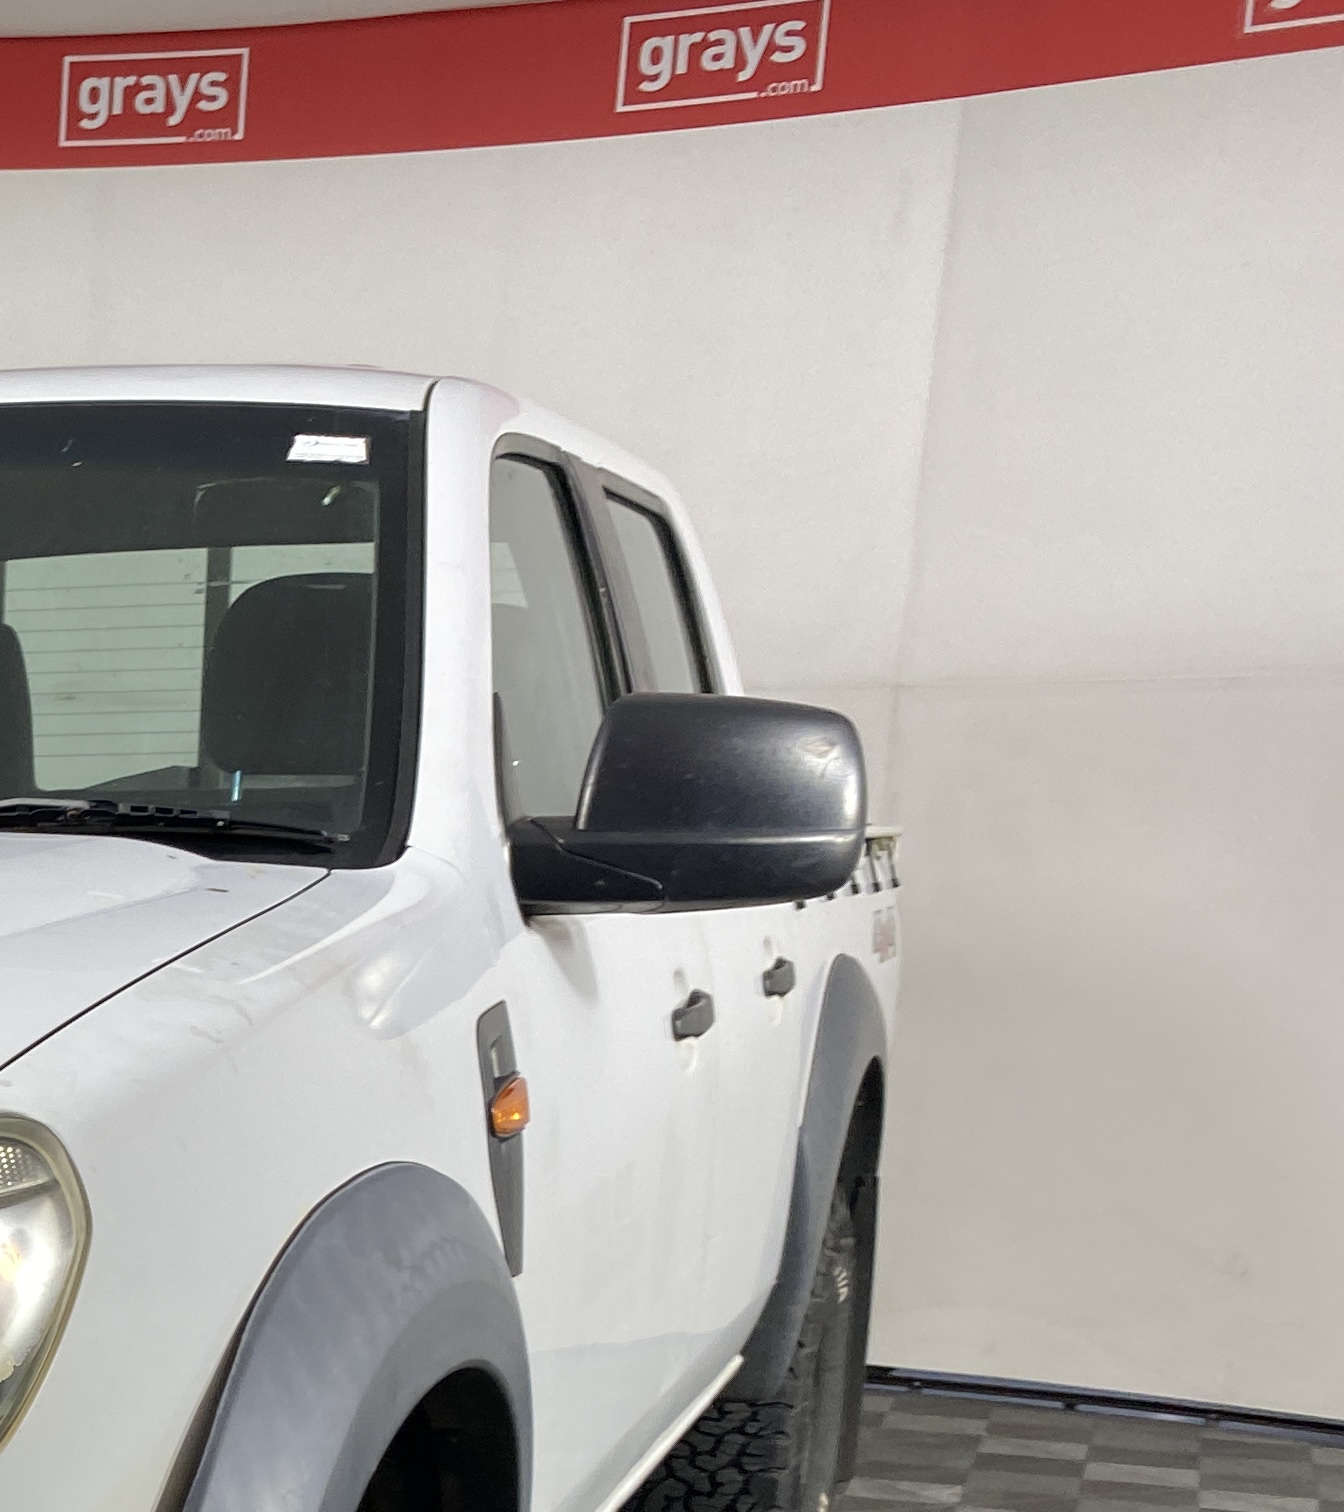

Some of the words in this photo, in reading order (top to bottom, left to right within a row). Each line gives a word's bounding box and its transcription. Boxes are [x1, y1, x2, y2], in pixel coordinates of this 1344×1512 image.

[637, 20, 807, 92] grays
[78, 71, 229, 130] grays
[759, 78, 809, 98] .com
